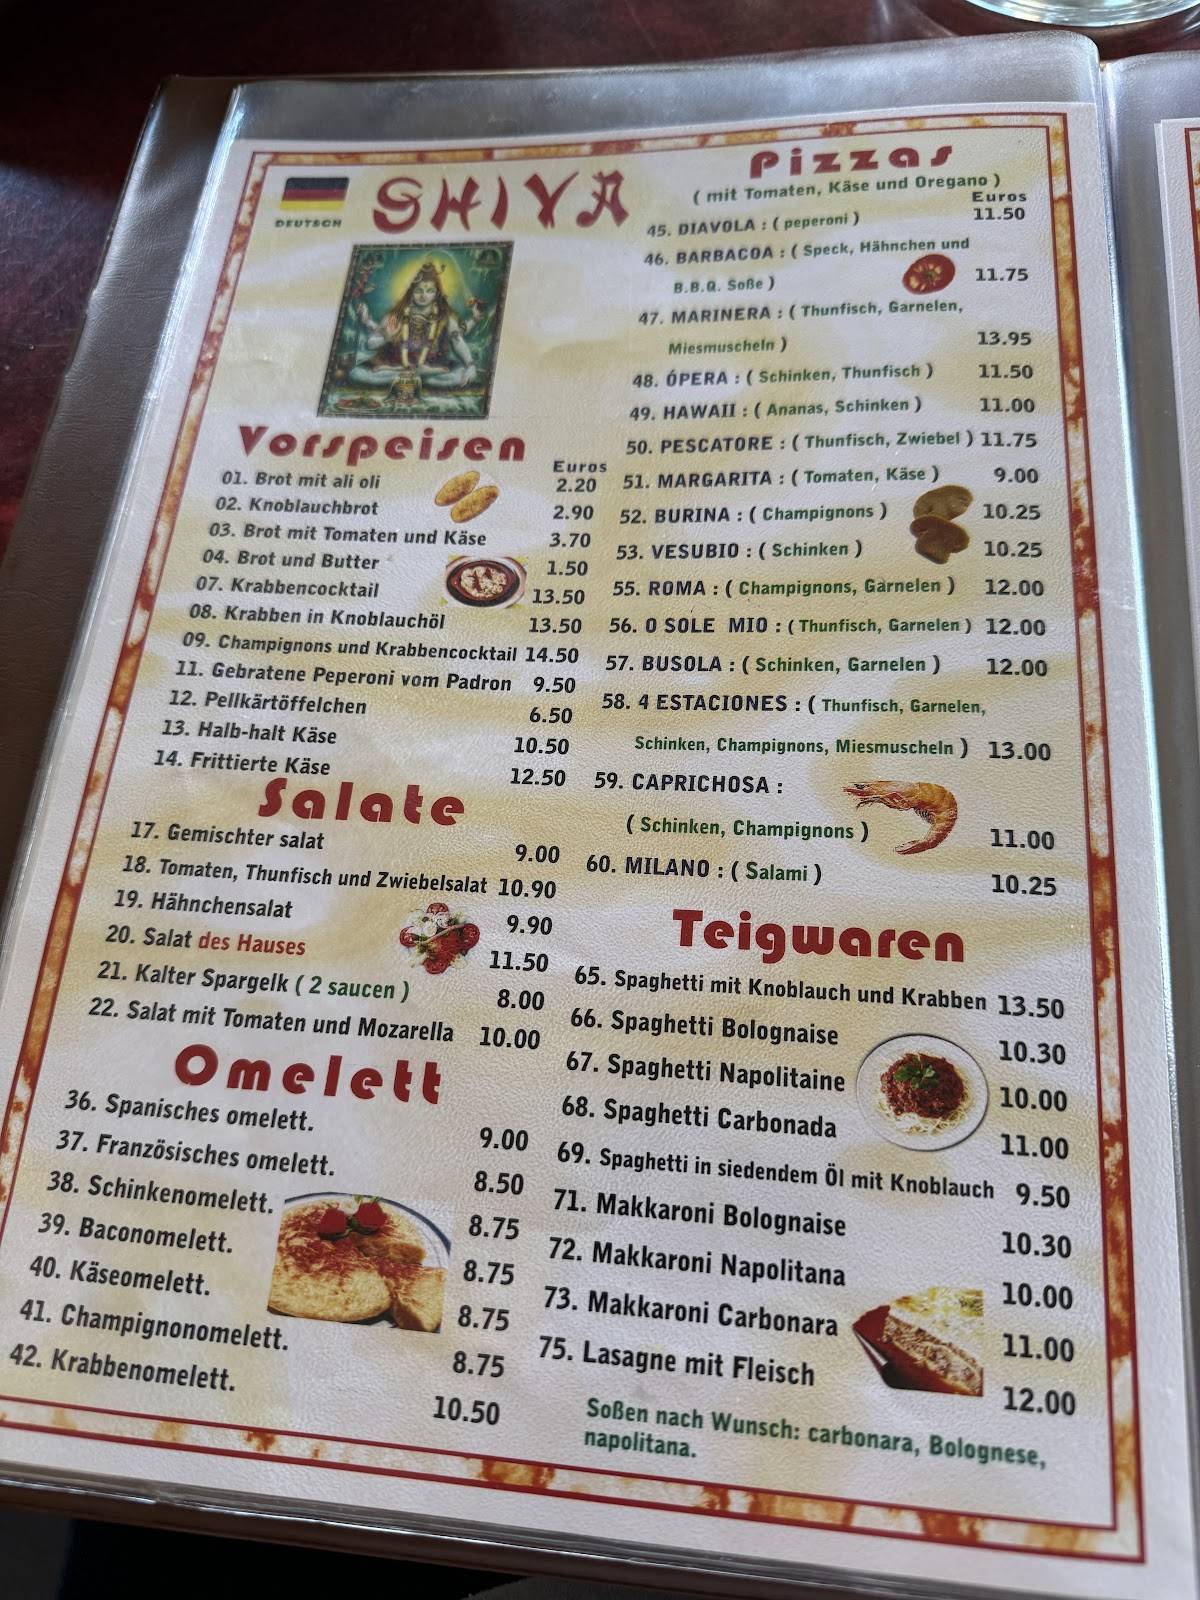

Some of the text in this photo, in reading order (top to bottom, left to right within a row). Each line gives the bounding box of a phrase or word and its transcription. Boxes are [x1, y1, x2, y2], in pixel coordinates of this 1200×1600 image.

[749, 144, 953, 180] Pizzas
[706, 175, 988, 203] mit Tomaten, Käse und Oregano
[971, 191, 1027, 203] Euros
[274, 218, 343, 228] DEUTSCH
[646, 212, 848, 238] 45. DIAVOLA peperoni
[975, 267, 1029, 282] 11.75
[638, 299, 963, 326] 47. MARINERA Thunfisch, Garnelen,
[668, 338, 775, 355] Miesmuscheln
[977, 331, 1032, 346] 13.95
[629, 398, 909, 422] 49. HAWAII Ananas, Schinken
[979, 397, 1036, 414] 11.00
[238, 424, 526, 466] Vorspeisen
[221, 470, 381, 489] 01. Brot mit ali oli
[552, 460, 607, 474] Euros
[622, 466, 926, 490] 51. MARGARITA Tomaten, Käse
[993, 466, 1039, 484] 9.00
[556, 477, 597, 493] 2.20
[208, 522, 487, 547] 03. Brot mit Tomaten und Käse
[548, 532, 591, 548] 3.70
[616, 541, 849, 561] 53. VESUBIO Schinken
[195, 575, 380, 599] 07. Krabbencocktail
[532, 588, 586, 606] 13.50
[608, 617, 638, 634] 56.
[663, 617, 716, 634] SOLE
[728, 616, 768, 634] MIO
[798, 618, 882, 635] Thunfisch,
[888, 617, 960, 632] Garnelen
[985, 618, 1047, 637] 12.00
[182, 631, 518, 662] 09. Champignons und Krabbencocktail
[525, 646, 580, 664] 14.50
[168, 689, 367, 715] 12. Pellkärtöffelchen
[601, 692, 986, 717] 58. 4 ESTACIONES Thunfisch, Garnelen,
[529, 706, 573, 725] 6.50
[634, 735, 954, 756] Schinken, Champignons, Miesmuscheln
[153, 749, 331, 776] 14. Frittierte Käse
[509, 767, 567, 787] 12.50
[593, 769, 770, 794] 59. CAPRICHOSA
[257, 777, 465, 827] Salate
[639, 816, 855, 841] Schinken, Champignons
[990, 828, 1055, 851] 11.00
[122, 854, 488, 894] 18. Tomaten, Thunfisch und Zwiebelsalat
[497, 878, 557, 900] 10.90
[104, 924, 306, 956] 20. Salat des Hauses
[672, 908, 965, 965] Teigwaren
[489, 950, 549, 973] 11.50
[96, 960, 395, 999] 21. Kalter Spargelk 2 saucen
[574, 965, 987, 1011] 65. Spaghetti mit Knoblauch und Krabben
[496, 988, 545, 1011] 8.00
[174, 1043, 442, 1105] Omelett
[566, 1050, 845, 1093] 67. Spaghetti Napolitaine
[64, 1089, 314, 1132] 36. Spanisches omelett.
[999, 1086, 1068, 1113] 10.00
[479, 1126, 529, 1152] 9.00
[557, 1140, 995, 1200] 69. Spaghetti in siedendem Öl mit Knoblauch
[46, 1170, 274, 1215] 38. Schinkenomelett.
[462, 1259, 515, 1286] 8.75
[549, 1236, 846, 1287] 72. Makkaroni Napolitana
[29, 1255, 210, 1296] 40. Käseomelett.
[1002, 1281, 1074, 1311] 10.00
[9, 1343, 235, 1392] 42. Krabbenomelett.
[452, 1350, 505, 1378] 8.75
[539, 1335, 815, 1387] 75. Lasagne mit Fleisch
[432, 1395, 501, 1426] 10.50
[1002, 1385, 1076, 1417] 12.00
[584, 1430, 697, 1458] napolitana.
[586, 1397, 1046, 1470] Soßen nach Wunsch: carbonara, Bolognese,
